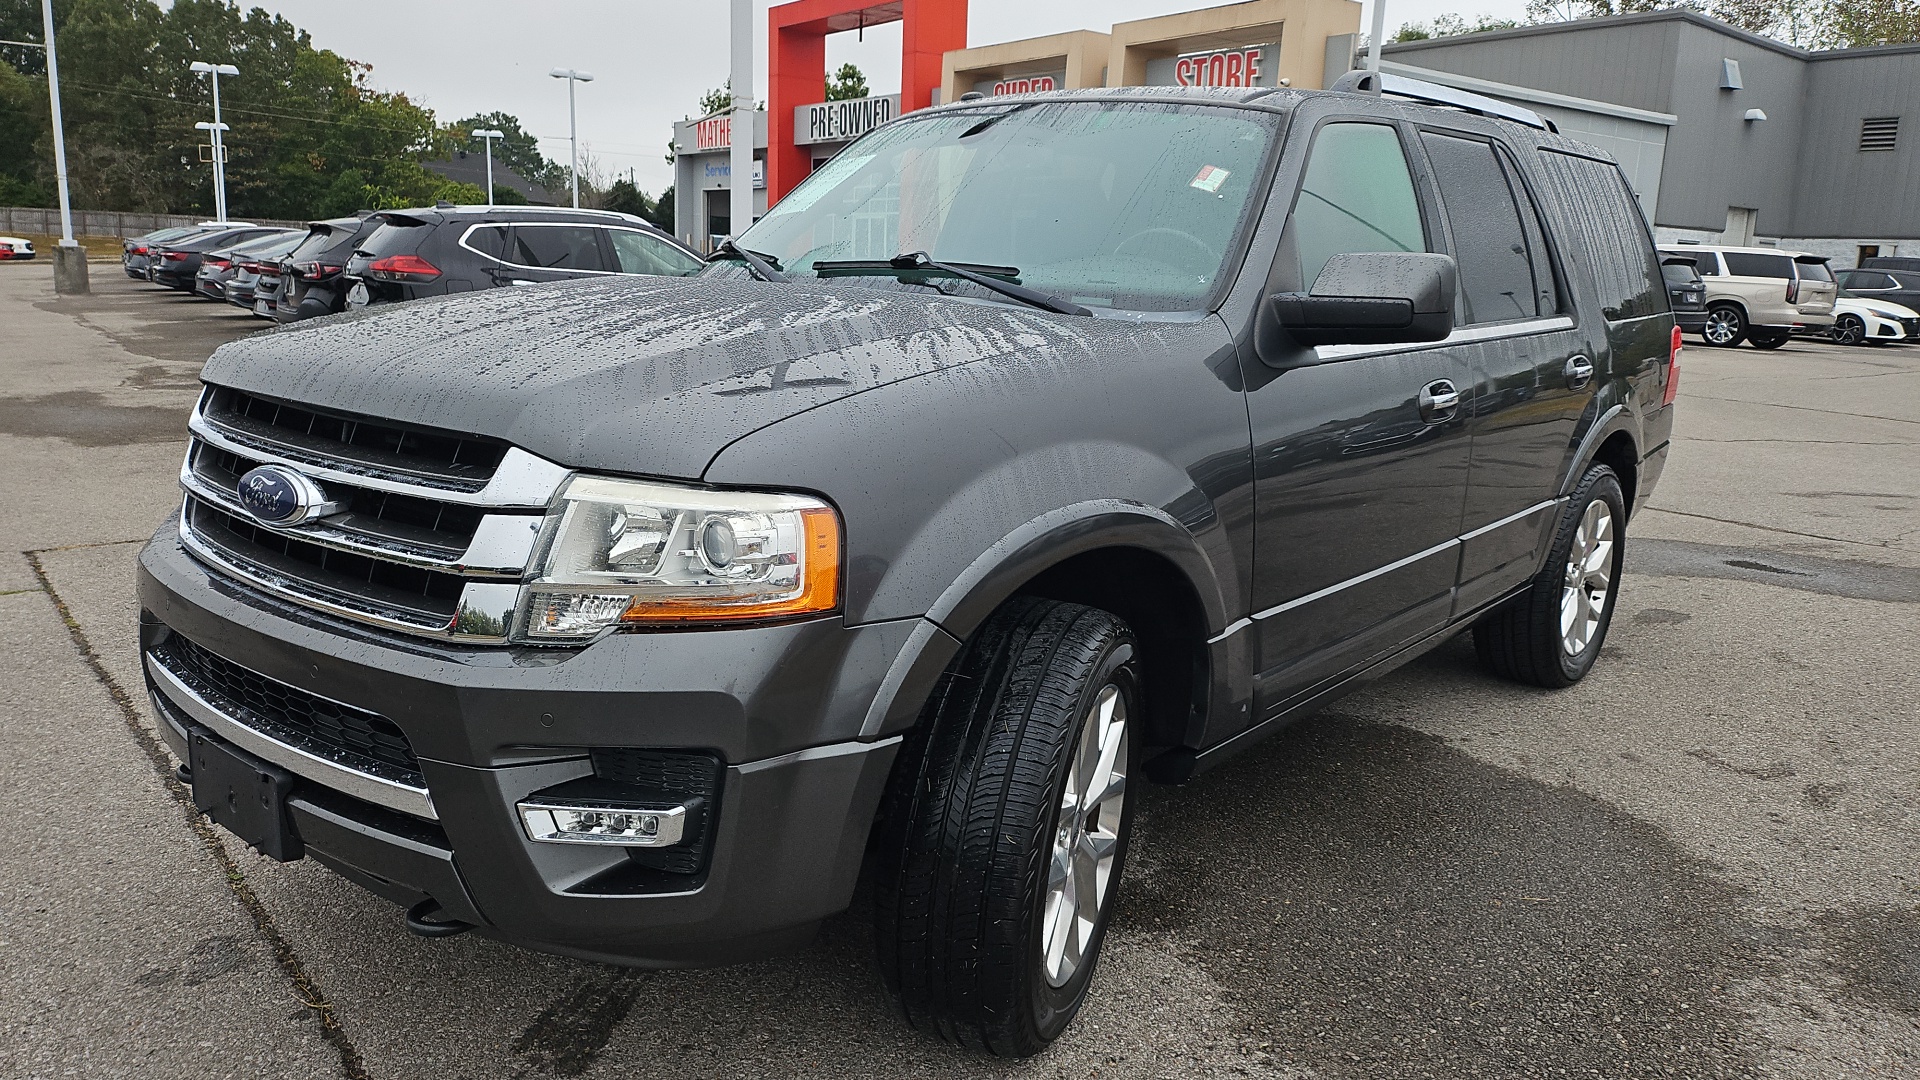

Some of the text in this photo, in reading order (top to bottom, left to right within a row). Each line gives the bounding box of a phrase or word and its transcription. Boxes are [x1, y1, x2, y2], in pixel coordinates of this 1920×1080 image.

[1175, 50, 1260, 87] STORE
[810, 98, 890, 138] PRE-OWNED
[245, 475, 283, 512] Ford
